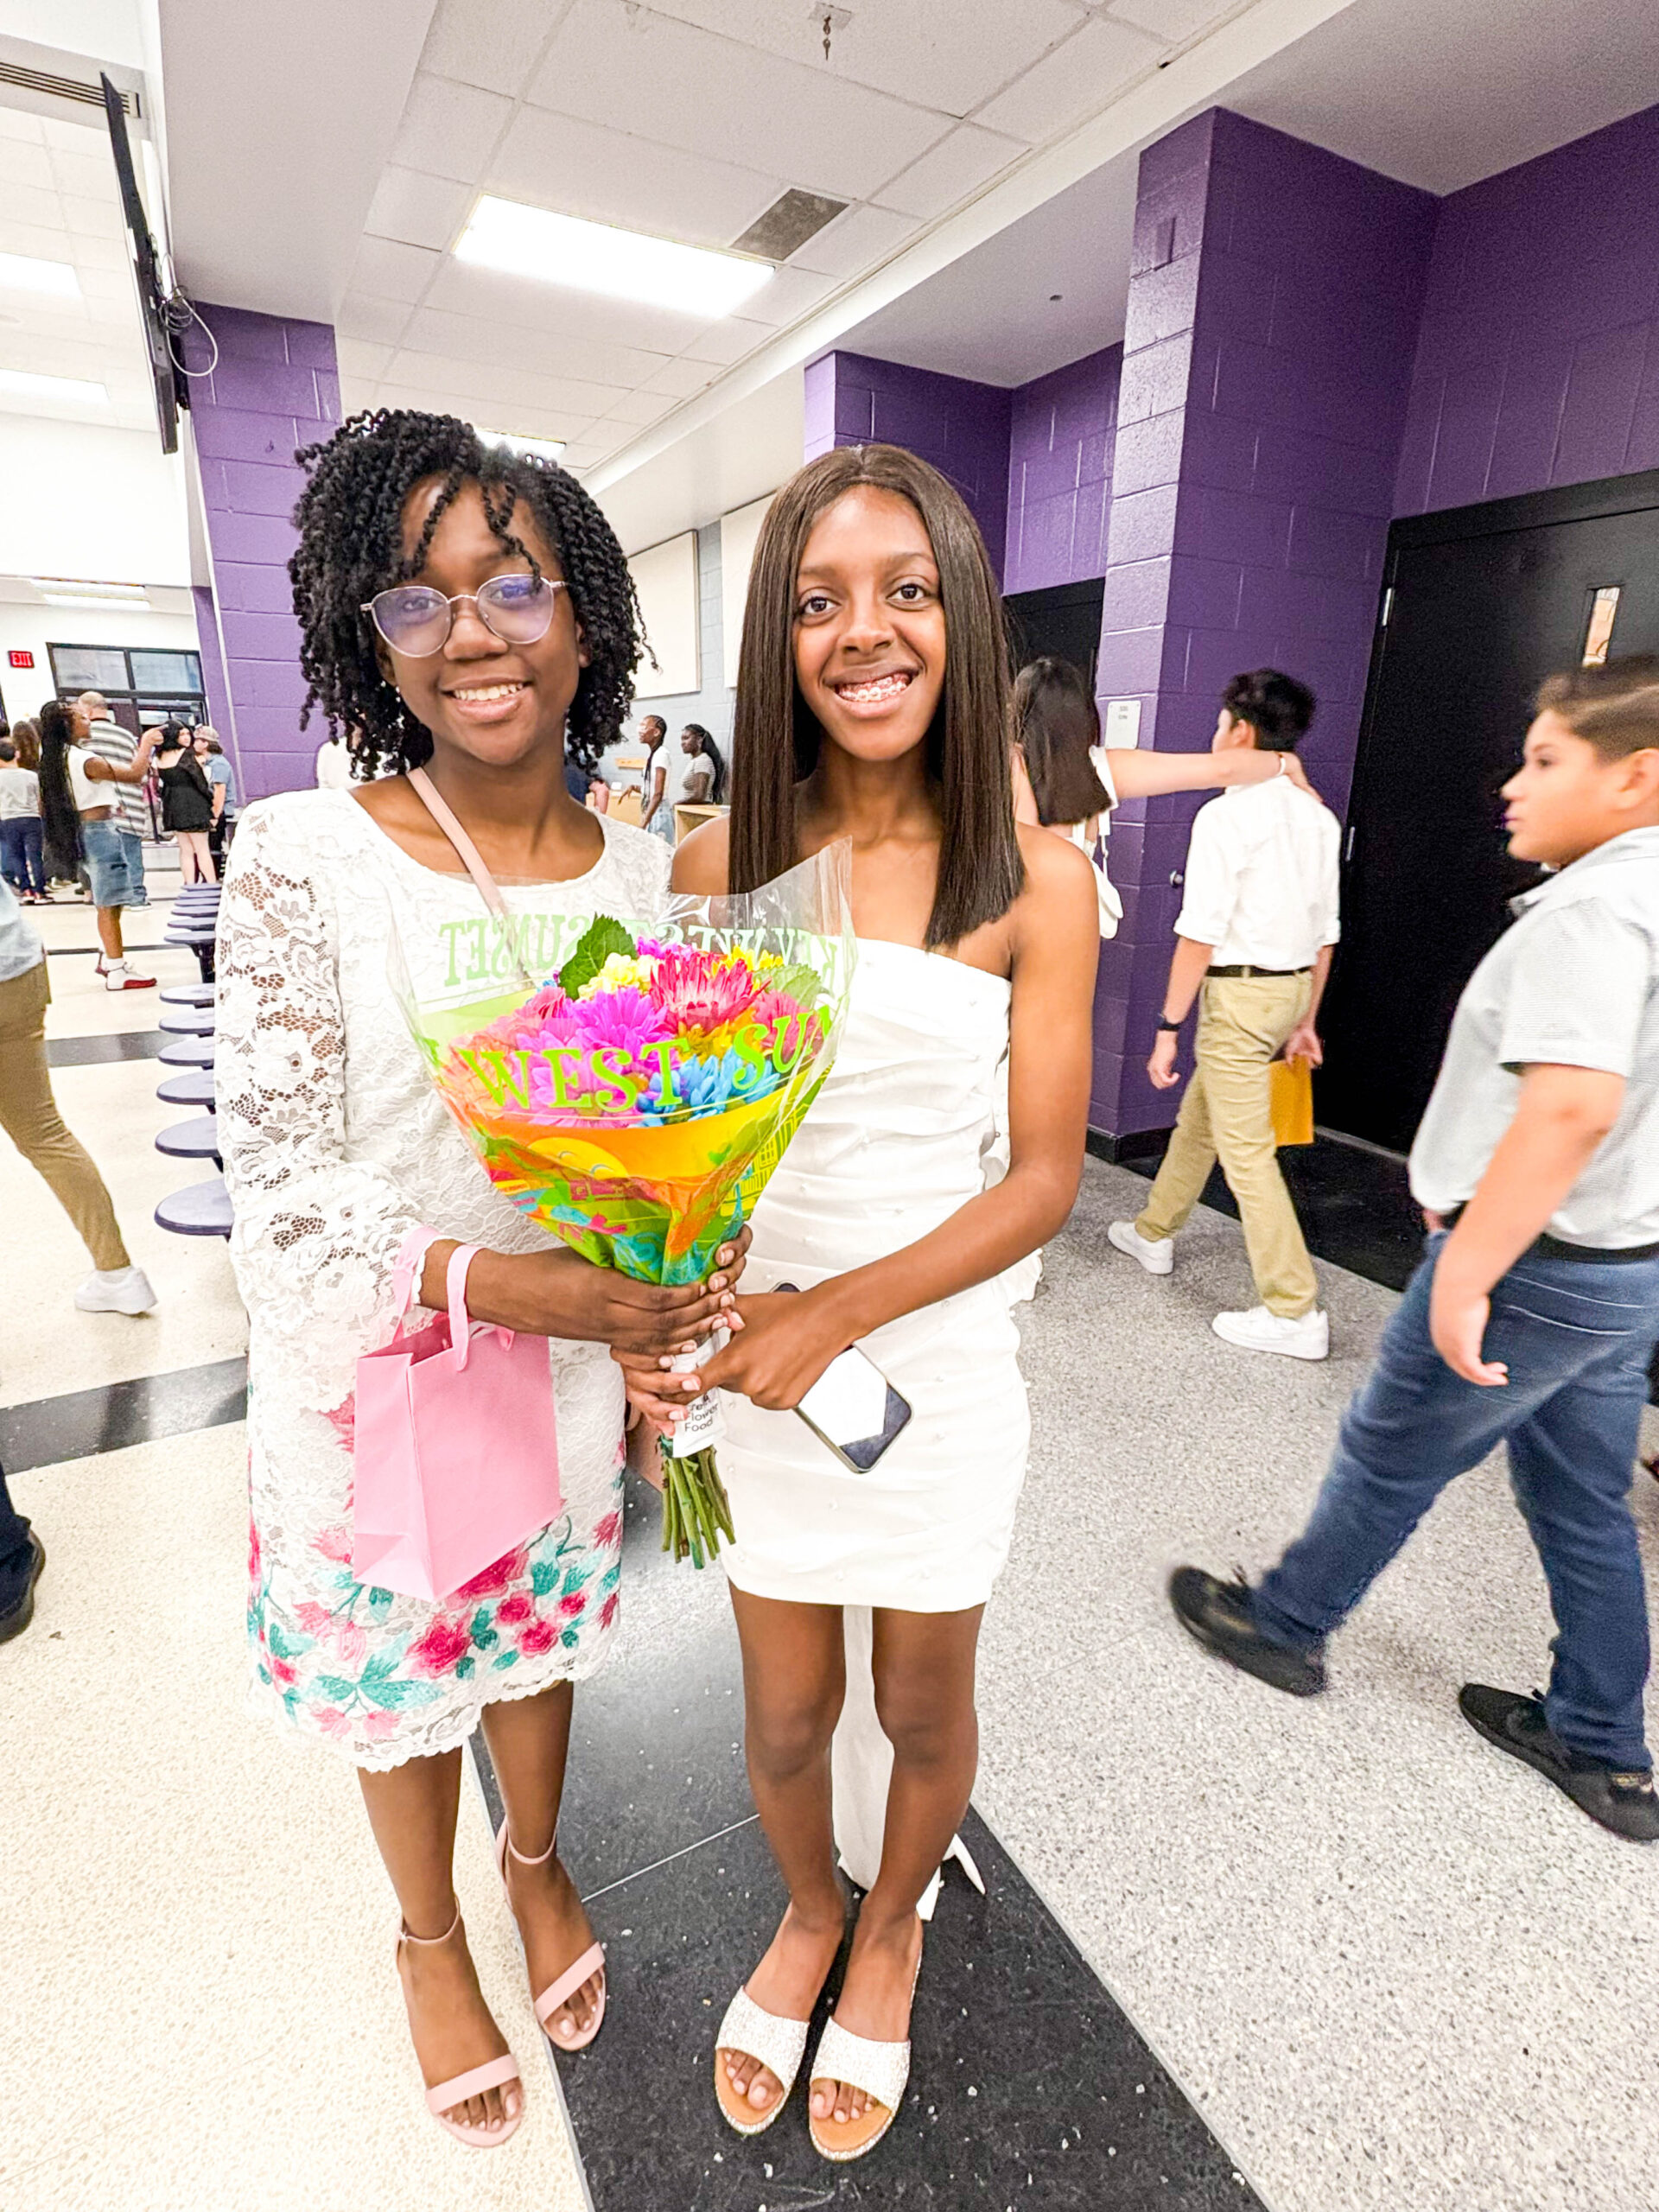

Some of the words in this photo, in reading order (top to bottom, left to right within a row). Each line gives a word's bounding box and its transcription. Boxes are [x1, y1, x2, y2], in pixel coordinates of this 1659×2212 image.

[11, 652, 32, 666] EXIT
[457, 1038, 690, 1112] WEST
[688, 1402, 719, 1422] lower
[684, 1415, 714, 1432] Food
